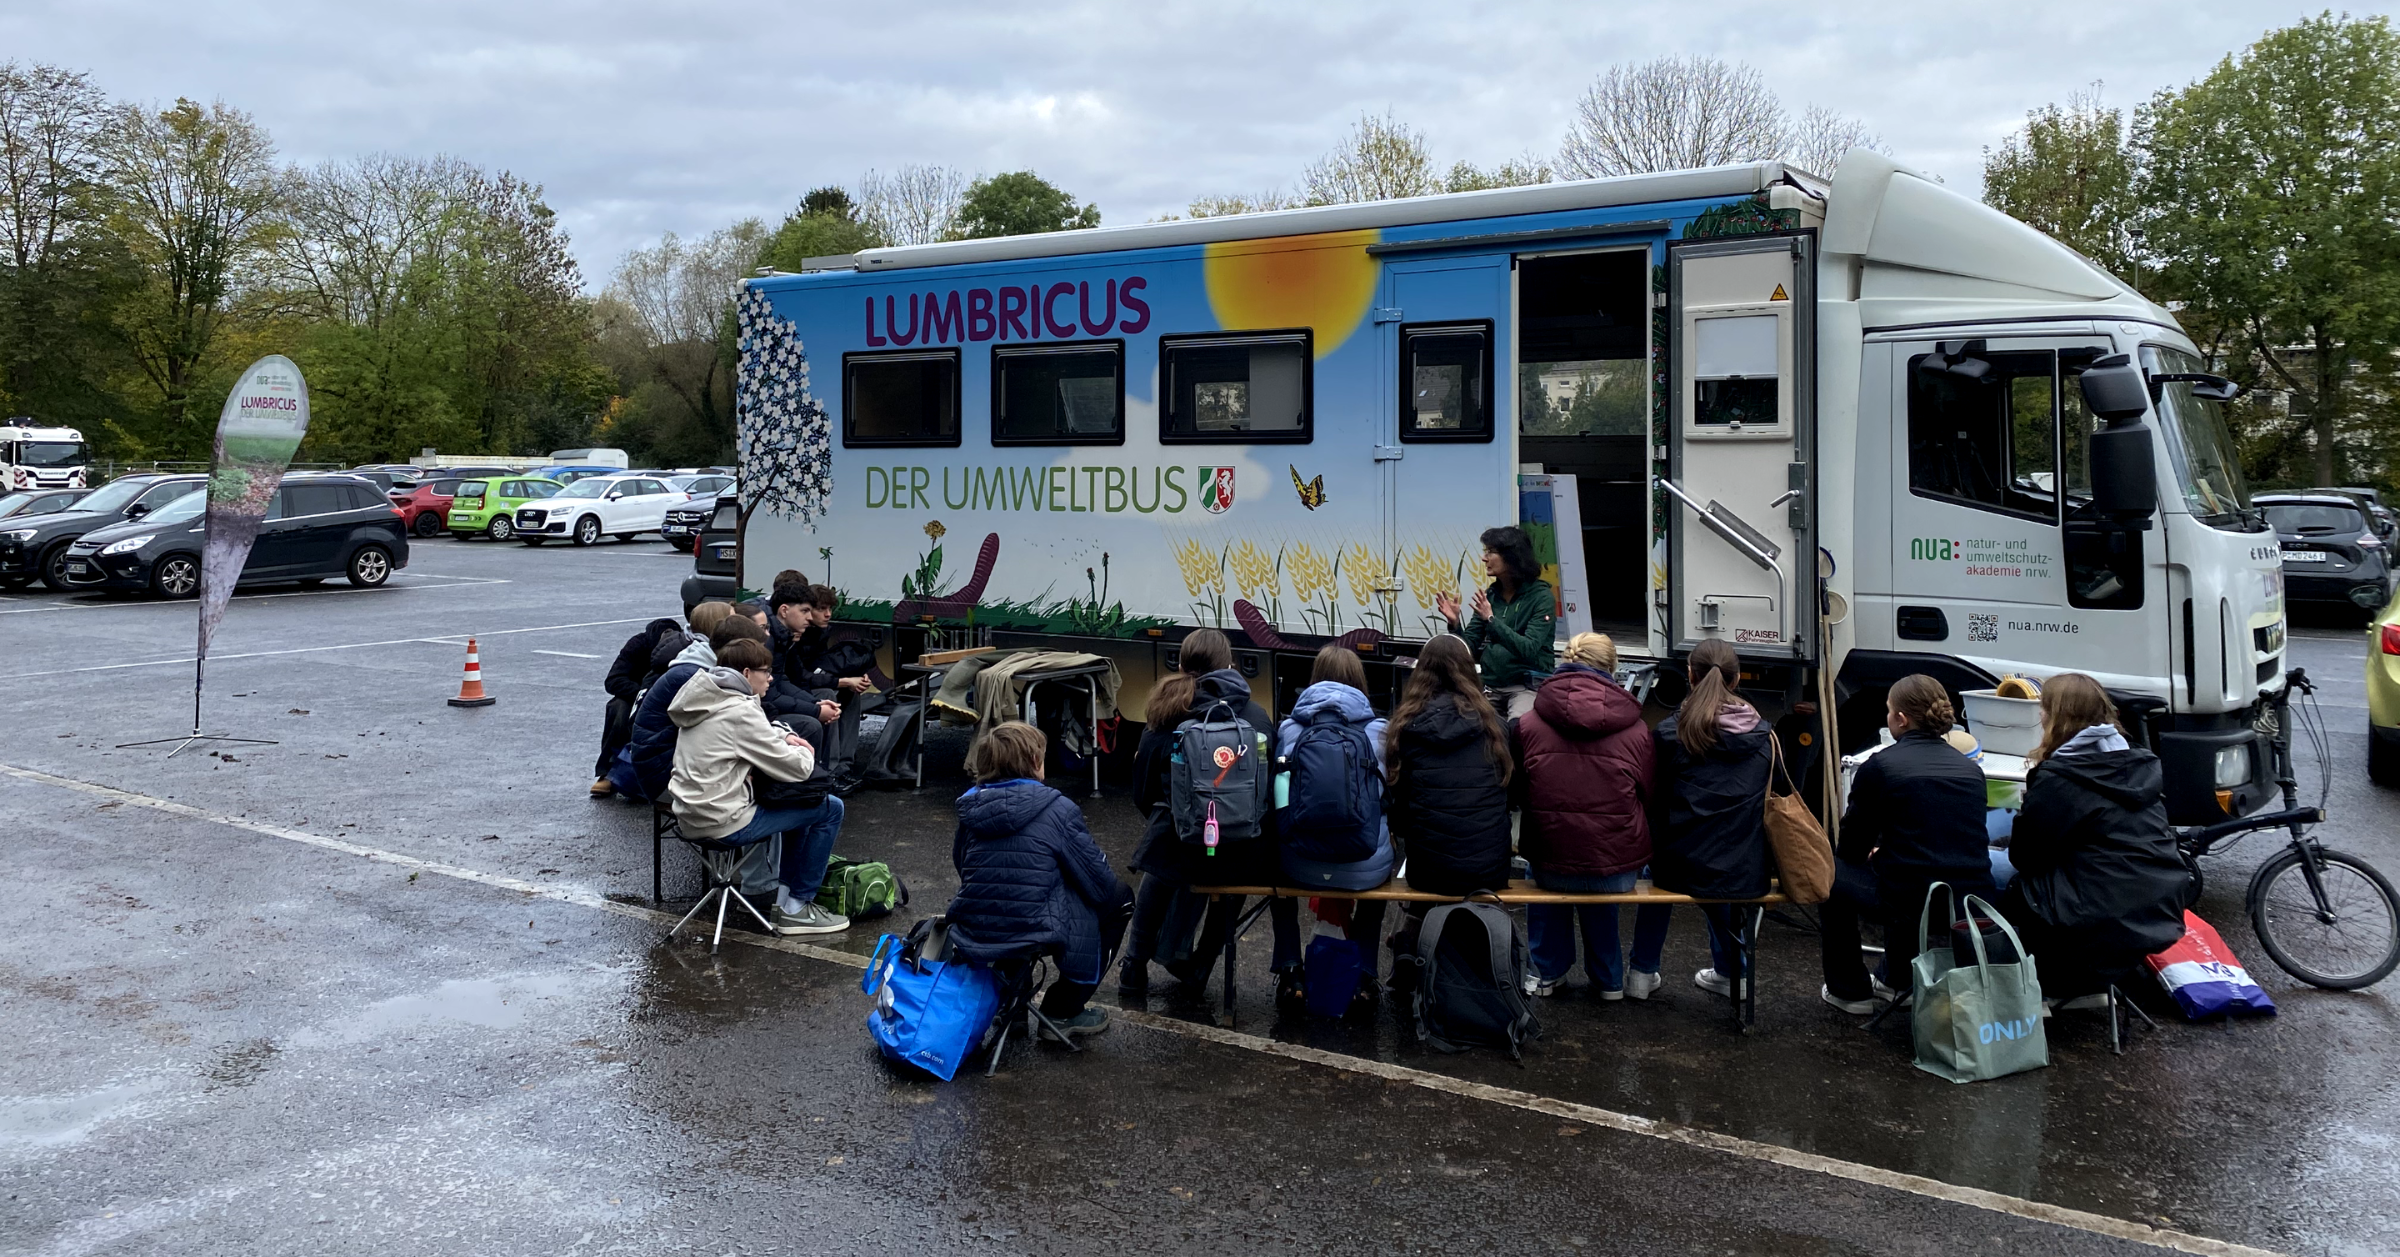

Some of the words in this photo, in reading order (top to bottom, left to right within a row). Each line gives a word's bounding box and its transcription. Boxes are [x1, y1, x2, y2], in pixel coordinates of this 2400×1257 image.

[865, 276, 1151, 347] LUMBRICUS
[241, 396, 297, 411] LUMBRICUS
[866, 466, 930, 510] DER
[943, 466, 1187, 514] UMWELTBUS
[1966, 538, 2001, 550] natur-
[2005, 538, 2027, 550] und
[1966, 551, 2053, 565] umweltschutz-
[1966, 565, 2021, 577] akademie
[2025, 567, 2052, 578] nrw.
[1748, 629, 1779, 639] KAISER
[2008, 621, 2079, 634] nua.nrw.de
[1979, 1013, 2037, 1045] ONLY
